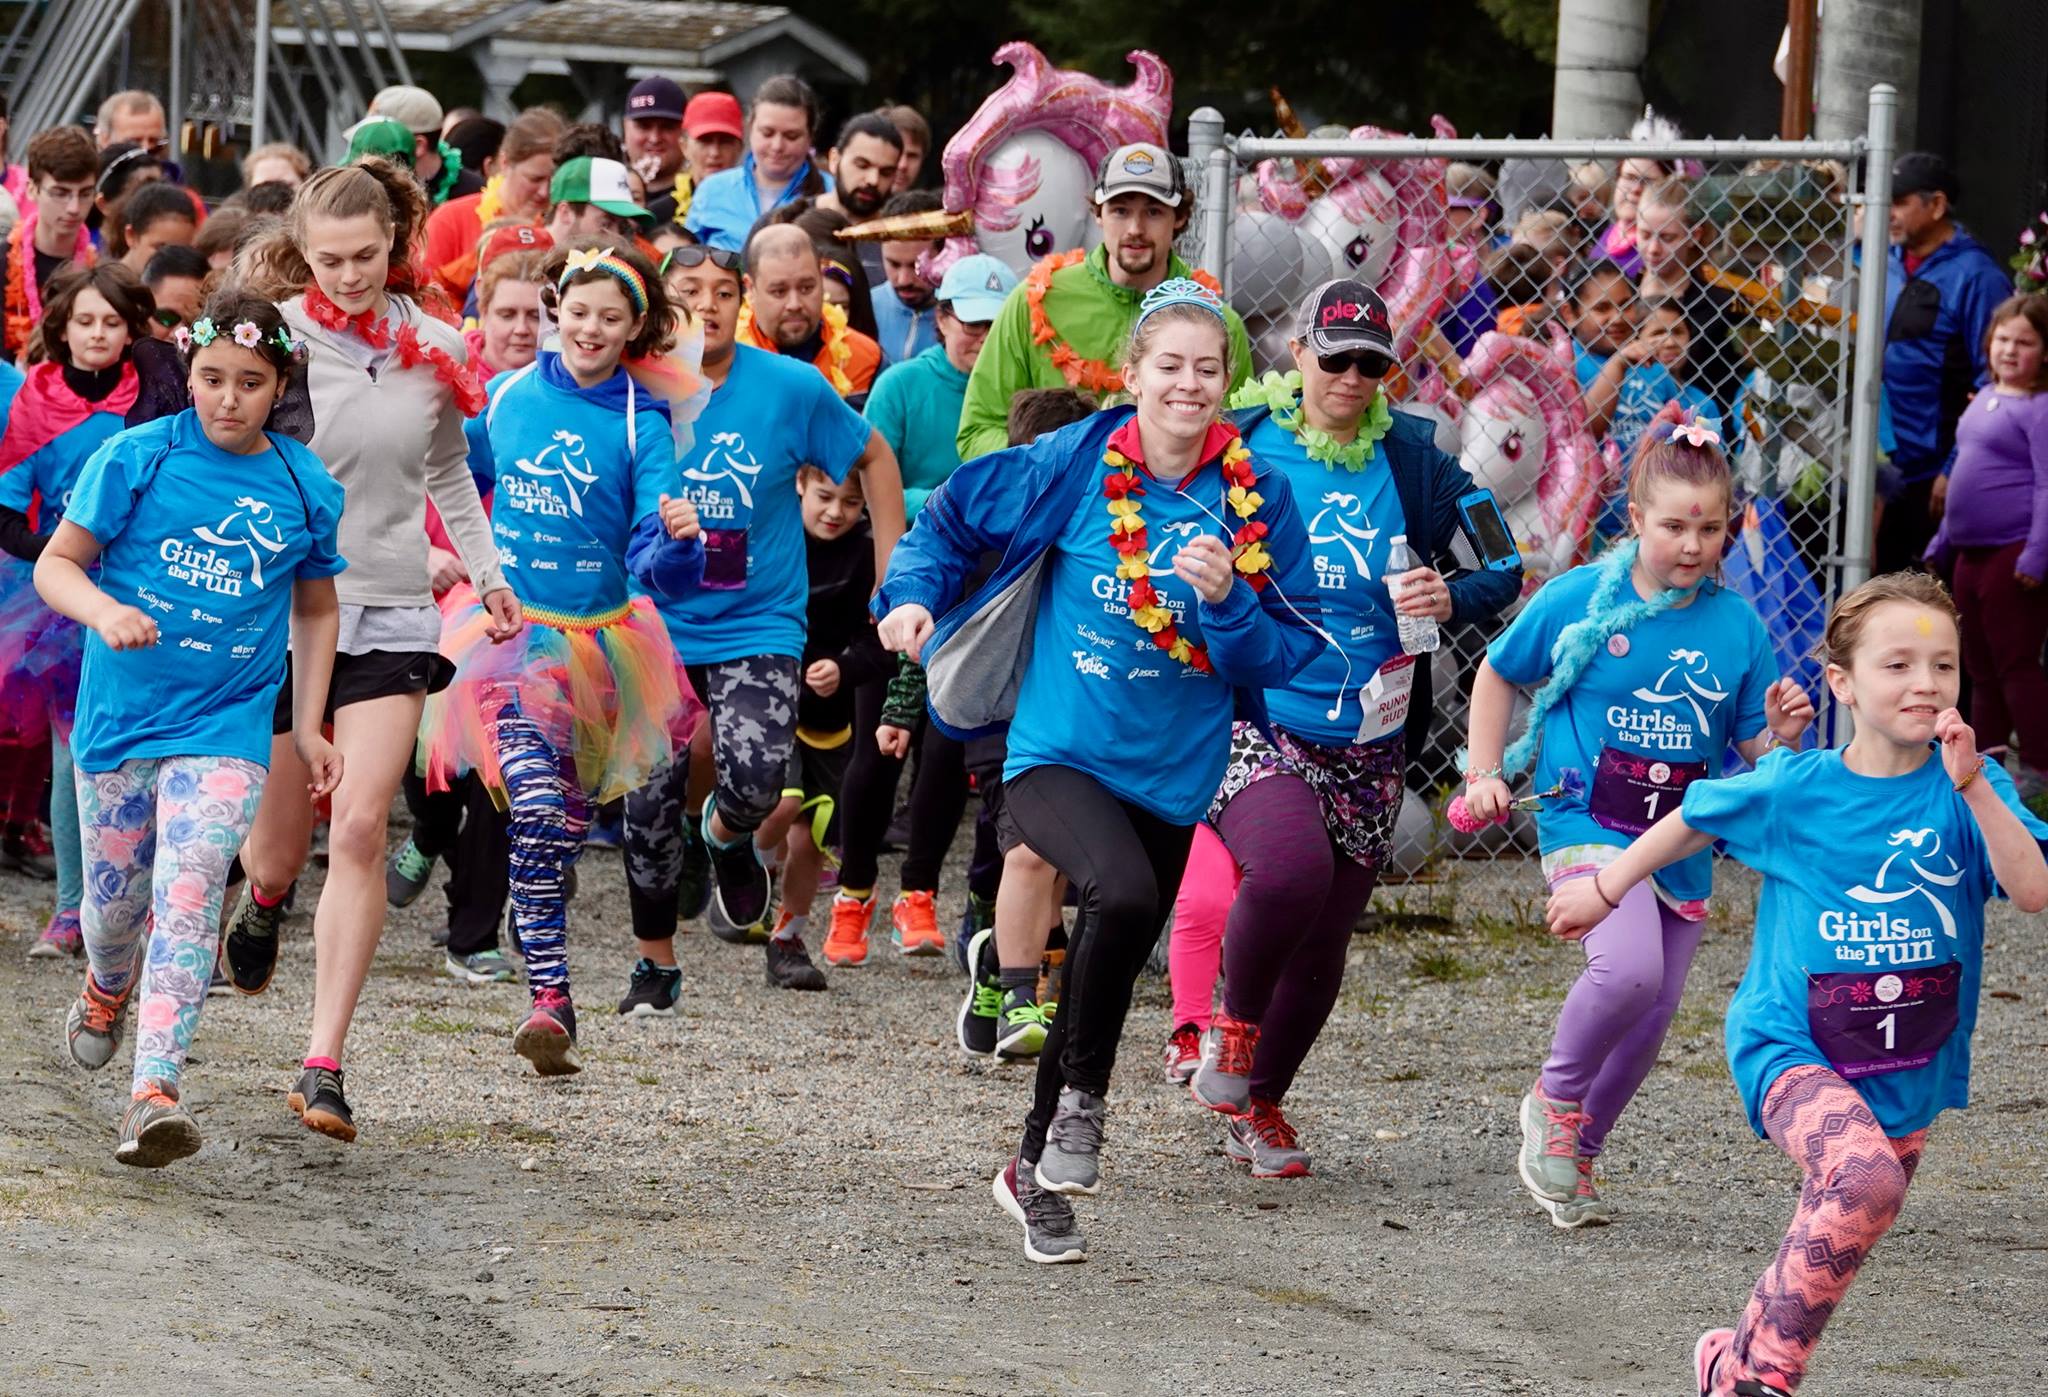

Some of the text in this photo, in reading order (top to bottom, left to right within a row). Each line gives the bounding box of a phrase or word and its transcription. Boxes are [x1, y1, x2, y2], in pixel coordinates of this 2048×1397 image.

[518, 228, 536, 244] S
[502, 475, 552, 502] Girls
[682, 484, 734, 505] irls on
[525, 497, 570, 518] run
[160, 538, 242, 579] Girls on
[1329, 564, 1346, 574] on
[168, 564, 242, 597] the run
[1091, 574, 1185, 609] Gis on
[1103, 601, 1127, 615] the
[1377, 691, 1409, 714] RUNN
[1381, 706, 1407, 726] BUD
[1607, 706, 1692, 732] Girls on
[1618, 730, 1693, 750] the run
[1643, 791, 1660, 820] 1
[1818, 910, 1933, 942] Girls on
[1835, 939, 1936, 966] the run
[1876, 1013, 1895, 1049] 1
